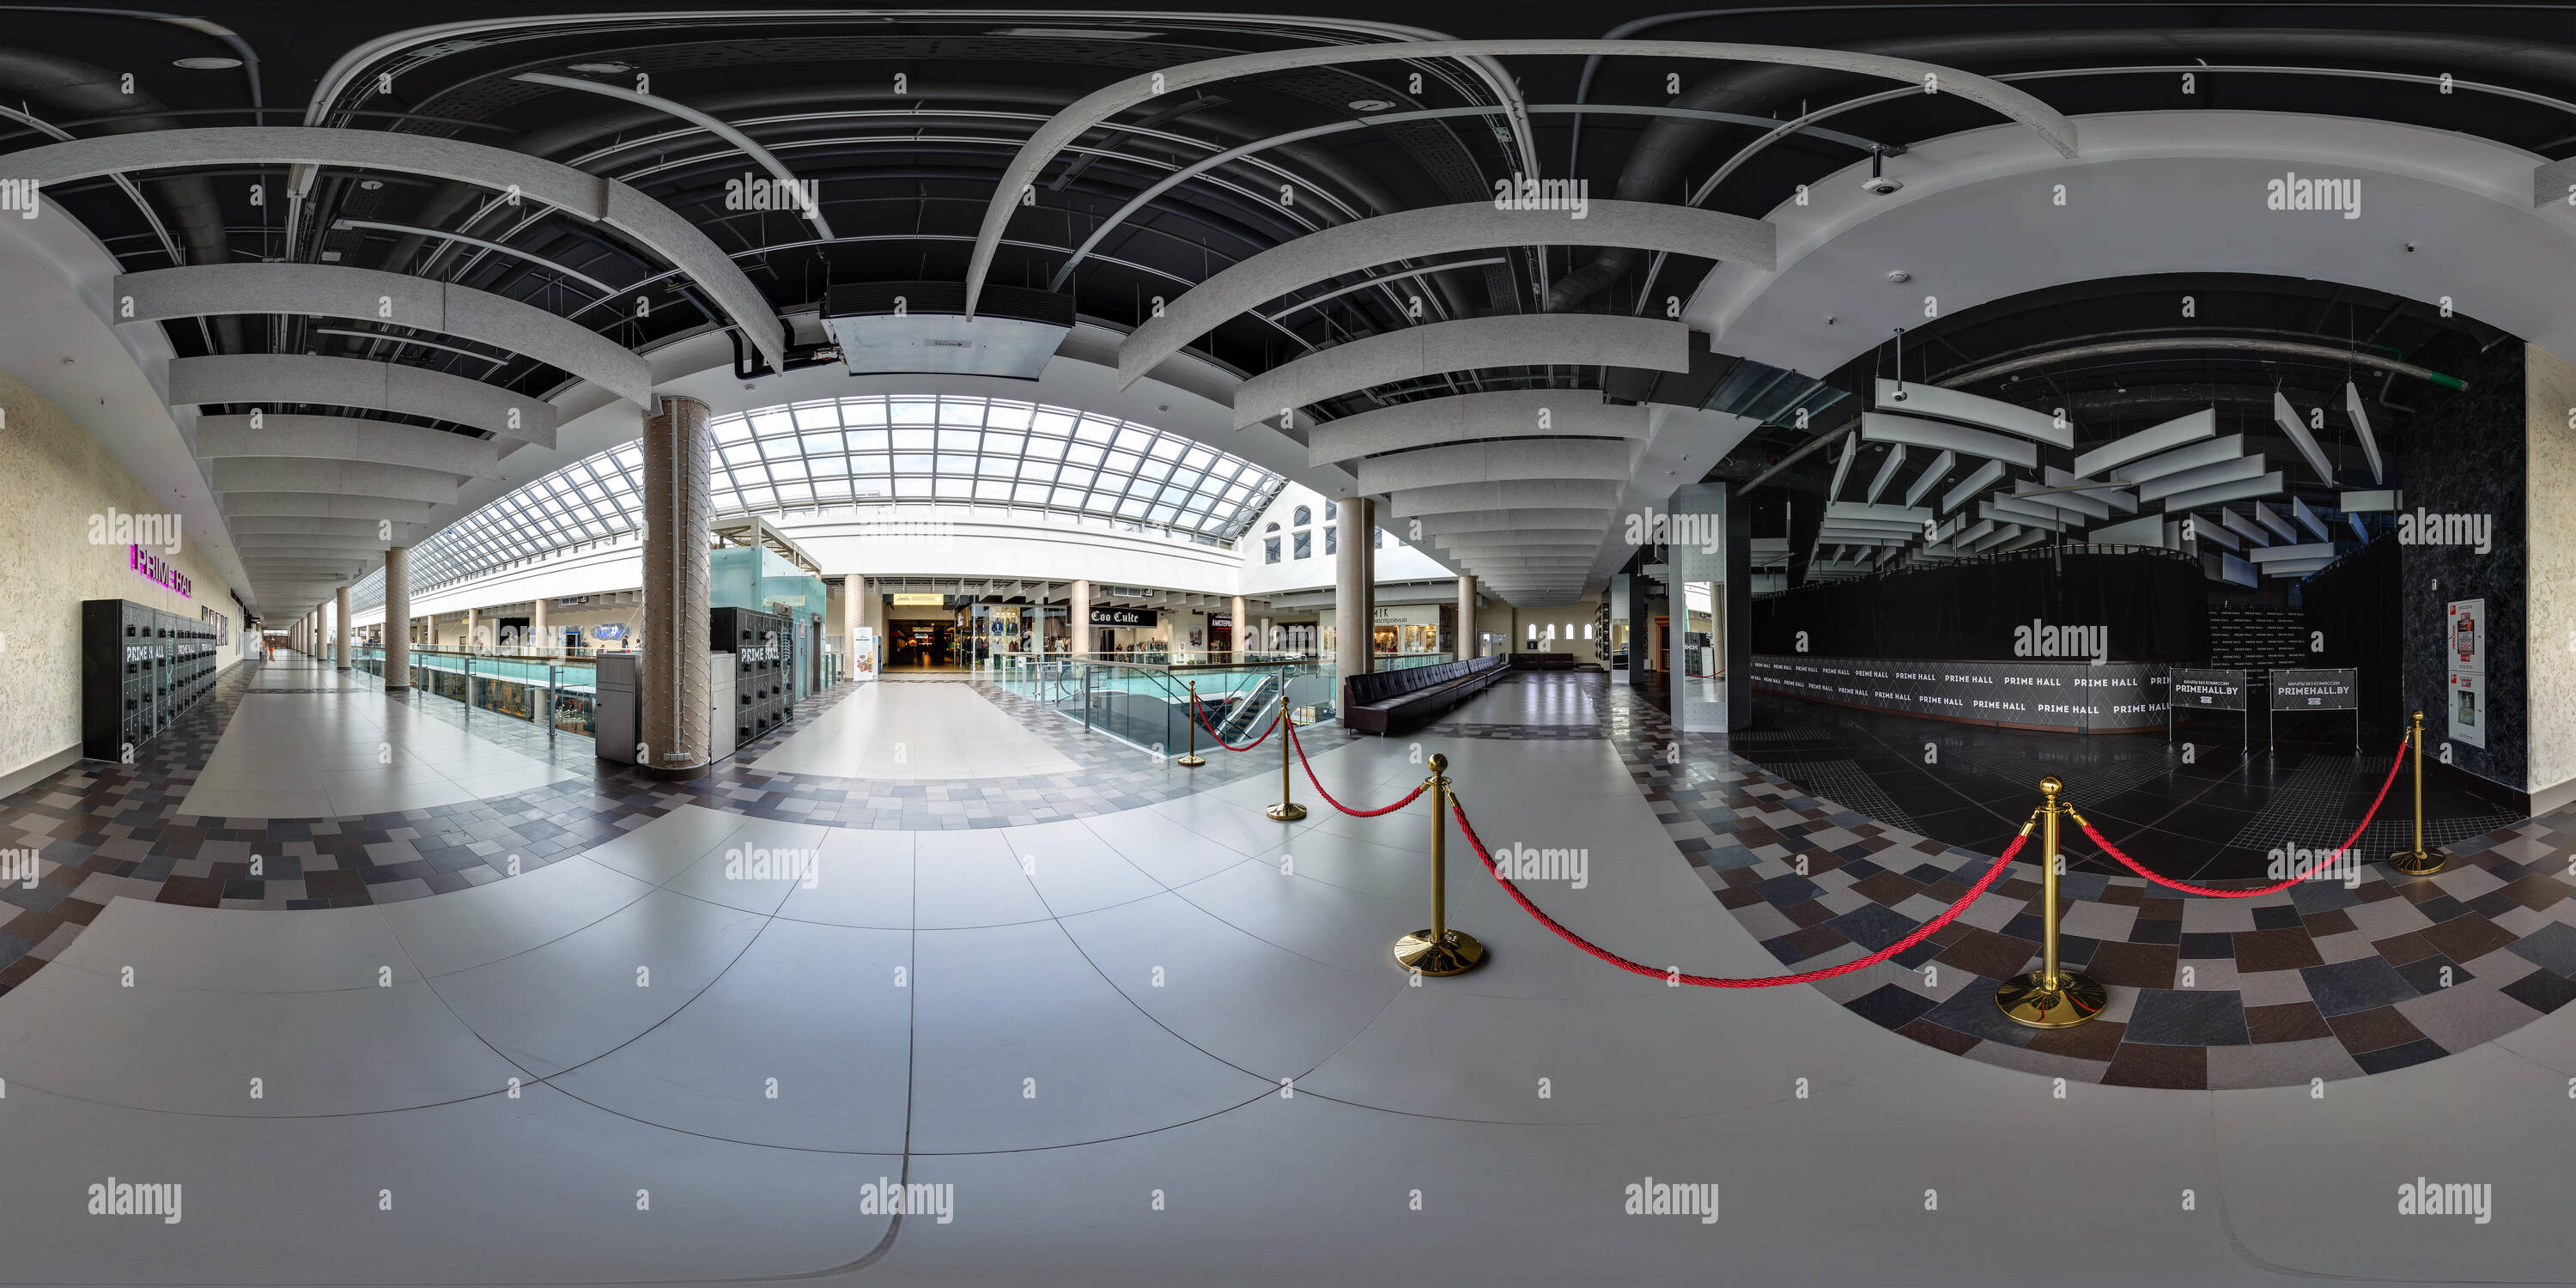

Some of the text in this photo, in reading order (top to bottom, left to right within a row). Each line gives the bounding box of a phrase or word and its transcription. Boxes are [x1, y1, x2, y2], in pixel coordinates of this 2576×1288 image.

[135, 544, 192, 598] PRIME HALL
[1091, 611, 1111, 622] Coo
[127, 646, 147, 662] PRIME
[742, 647, 779, 662] PRIME HALL
[2004, 677, 2061, 686] PRIME HALL
[2074, 678, 2138, 687] PRIME HALL
[2150, 677, 2170, 685] PRI
[2176, 684, 2239, 696] PRIMEHALL.BY
[2278, 686, 2350, 696] PRIMEHALL.BY
[1919, 696, 1941, 704] PRIME
[1973, 700, 2026, 711] PRIME HALL
[2038, 704, 2069, 713] PRIME
[2113, 702, 2171, 714] PRIME HALL
